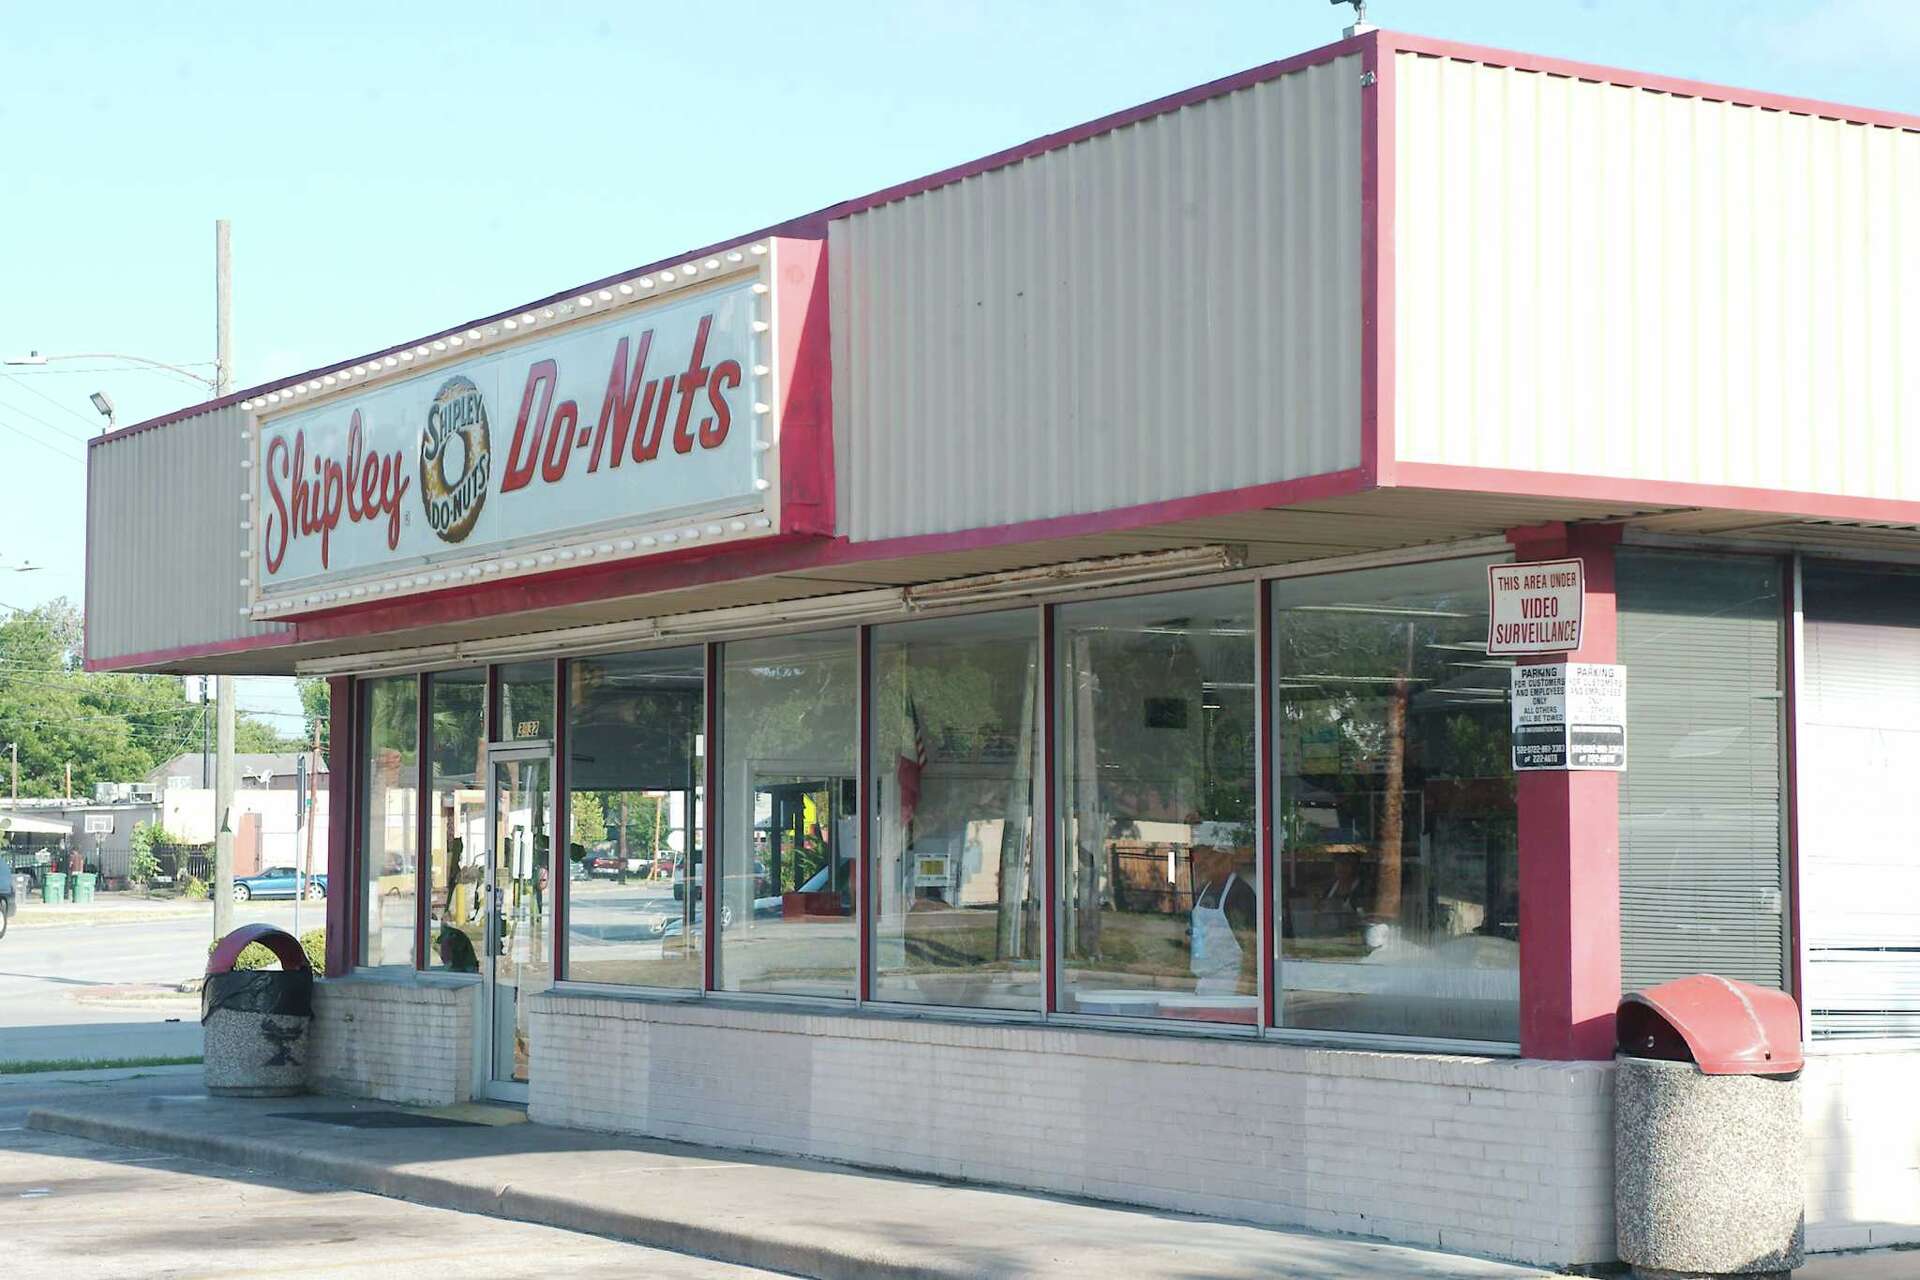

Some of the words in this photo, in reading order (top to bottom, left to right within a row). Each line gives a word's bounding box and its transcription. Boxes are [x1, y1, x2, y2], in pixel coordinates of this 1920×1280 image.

[500, 313, 742, 494] Do-Nuts
[425, 392, 483, 461] SHIPLEY
[265, 408, 410, 576] Shipley
[1497, 575, 1520, 591] THIS
[1523, 574, 1548, 590] AREA
[1550, 571, 1577, 588] UNDER
[1520, 596, 1558, 619] VIDEO
[1496, 620, 1577, 644] SURVEILLANCE
[1521, 667, 1557, 678] PARKING
[1577, 667, 1615, 678] PARKING
[1515, 688, 1529, 696] AND
[1530, 686, 1565, 696] EMPLOYEES
[1528, 678, 1565, 688] CUSTOMERS
[1532, 697, 1547, 705] ONLY
